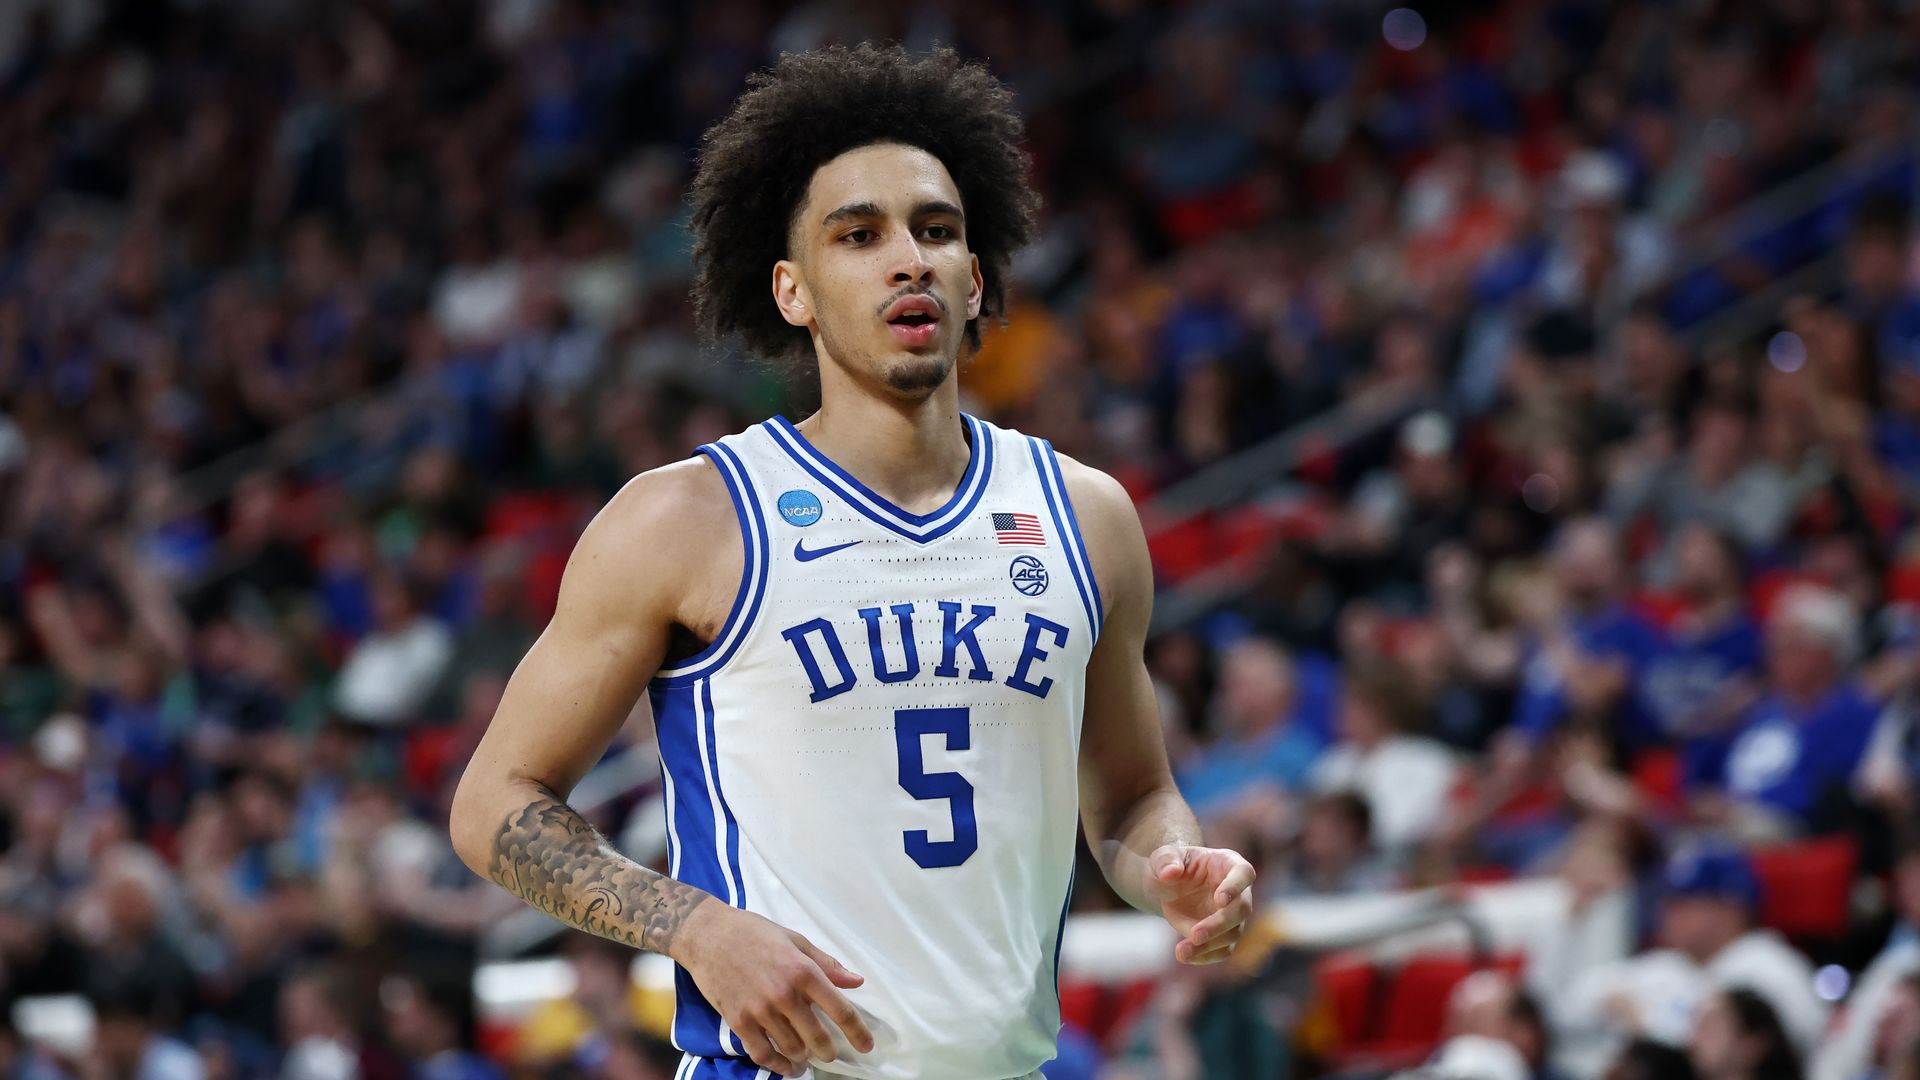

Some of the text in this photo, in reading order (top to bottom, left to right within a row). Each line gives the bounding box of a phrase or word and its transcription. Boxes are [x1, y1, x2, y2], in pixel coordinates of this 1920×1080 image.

[783, 506, 819, 517] NCAA
[1014, 568, 1046, 579] ACC
[781, 601, 1070, 703] DUKE
[894, 707, 978, 869] 5
